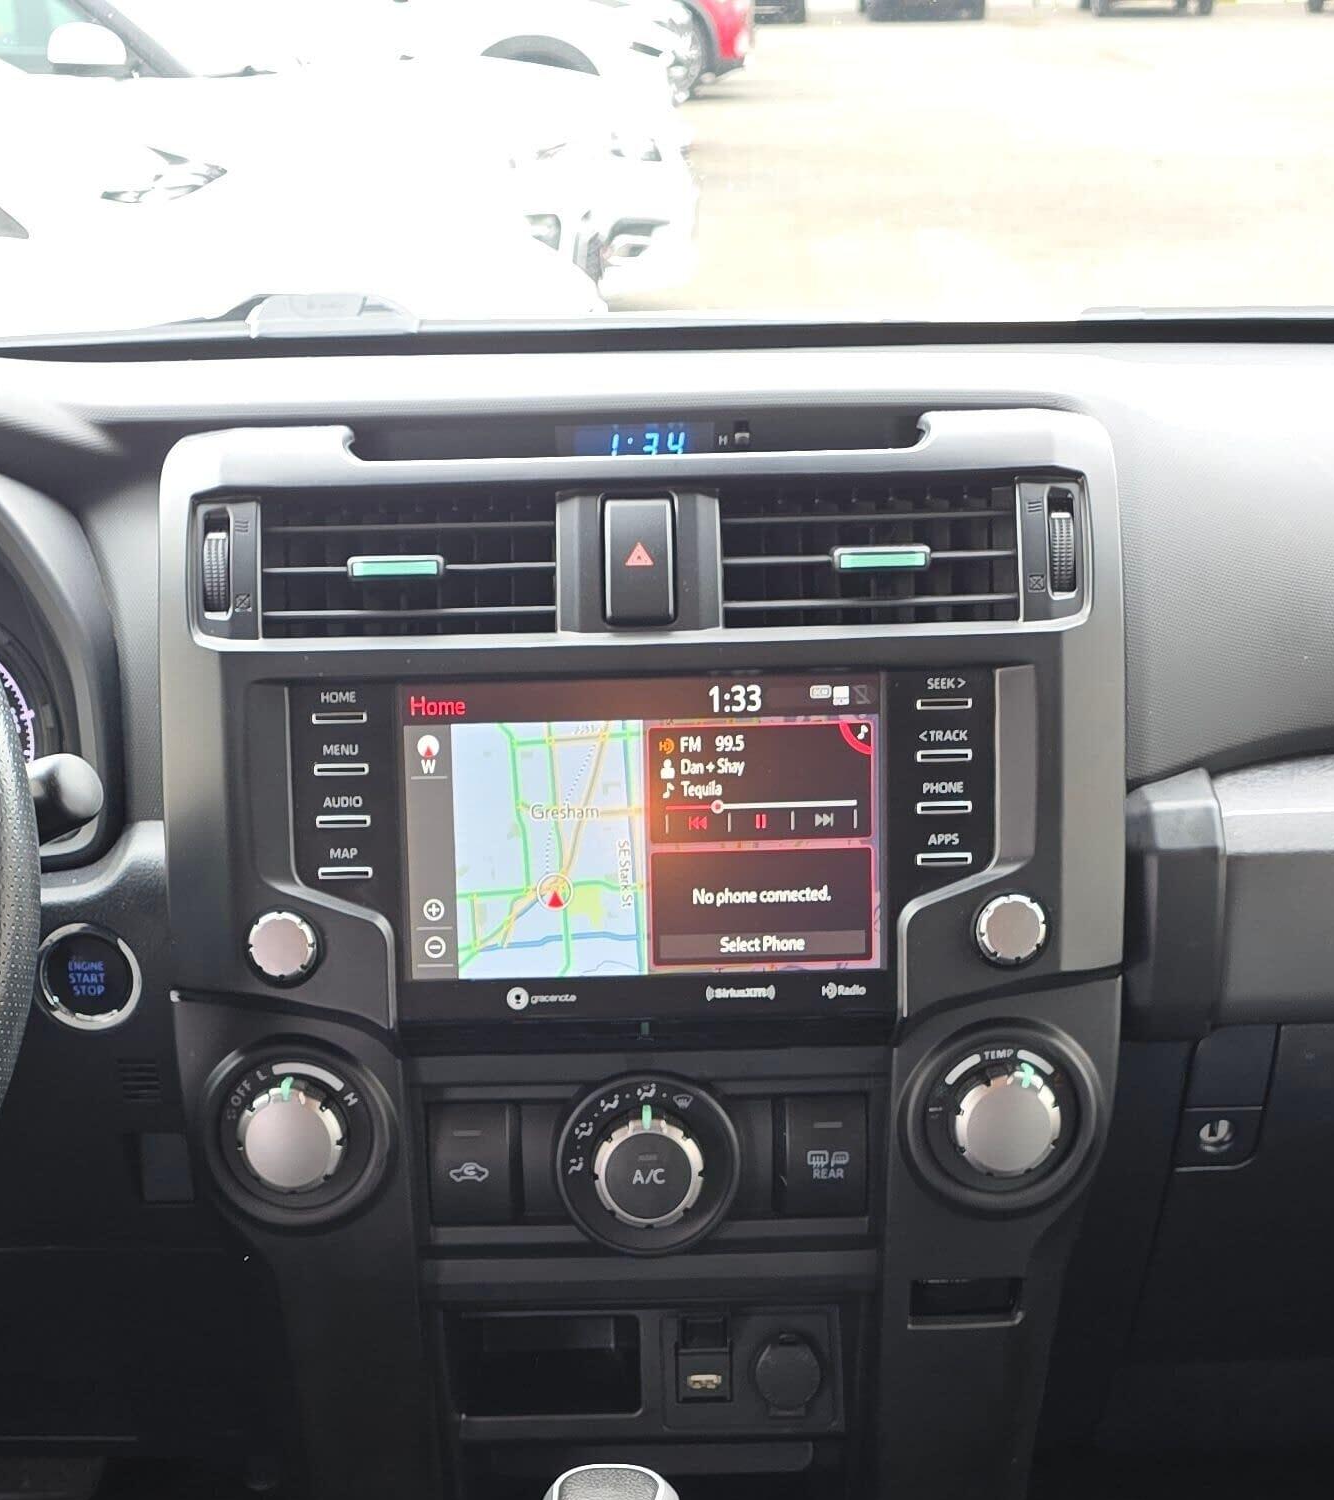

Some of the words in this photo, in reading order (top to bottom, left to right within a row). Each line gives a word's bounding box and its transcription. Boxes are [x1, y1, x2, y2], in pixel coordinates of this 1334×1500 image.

[320, 691, 357, 704] HOME
[708, 684, 762, 713] 1:33
[410, 696, 466, 717] Home
[322, 744, 359, 757] MENU
[680, 736, 702, 753] FM
[715, 735, 745, 752] 99.5
[421, 760, 436, 774] W
[680, 758, 705, 775] Dan
[716, 757, 746, 777] Shay
[680, 780, 723, 799] Tequila
[922, 781, 965, 794] PHONE
[322, 795, 363, 809] AUDIO
[530, 804, 600, 820] Gresham
[927, 833, 960, 845] APPS
[329, 847, 358, 860] MAP
[617, 840, 629, 857] SE
[619, 860, 633, 892] Stark
[622, 895, 633, 908] St
[692, 887, 714, 905] No
[716, 887, 757, 908] phone
[759, 884, 832, 904] connected.
[720, 936, 761, 953] Select
[762, 935, 805, 952] Phone
[68, 960, 105, 971] ENGINE
[69, 973, 105, 984] START
[72, 985, 105, 996] STOP
[838, 983, 867, 996] Radio
[983, 1049, 1014, 1061] TEMP
[230, 1079, 252, 1107] OFF
[631, 1167, 666, 1186] A/C
[812, 1168, 845, 1180] REAR
